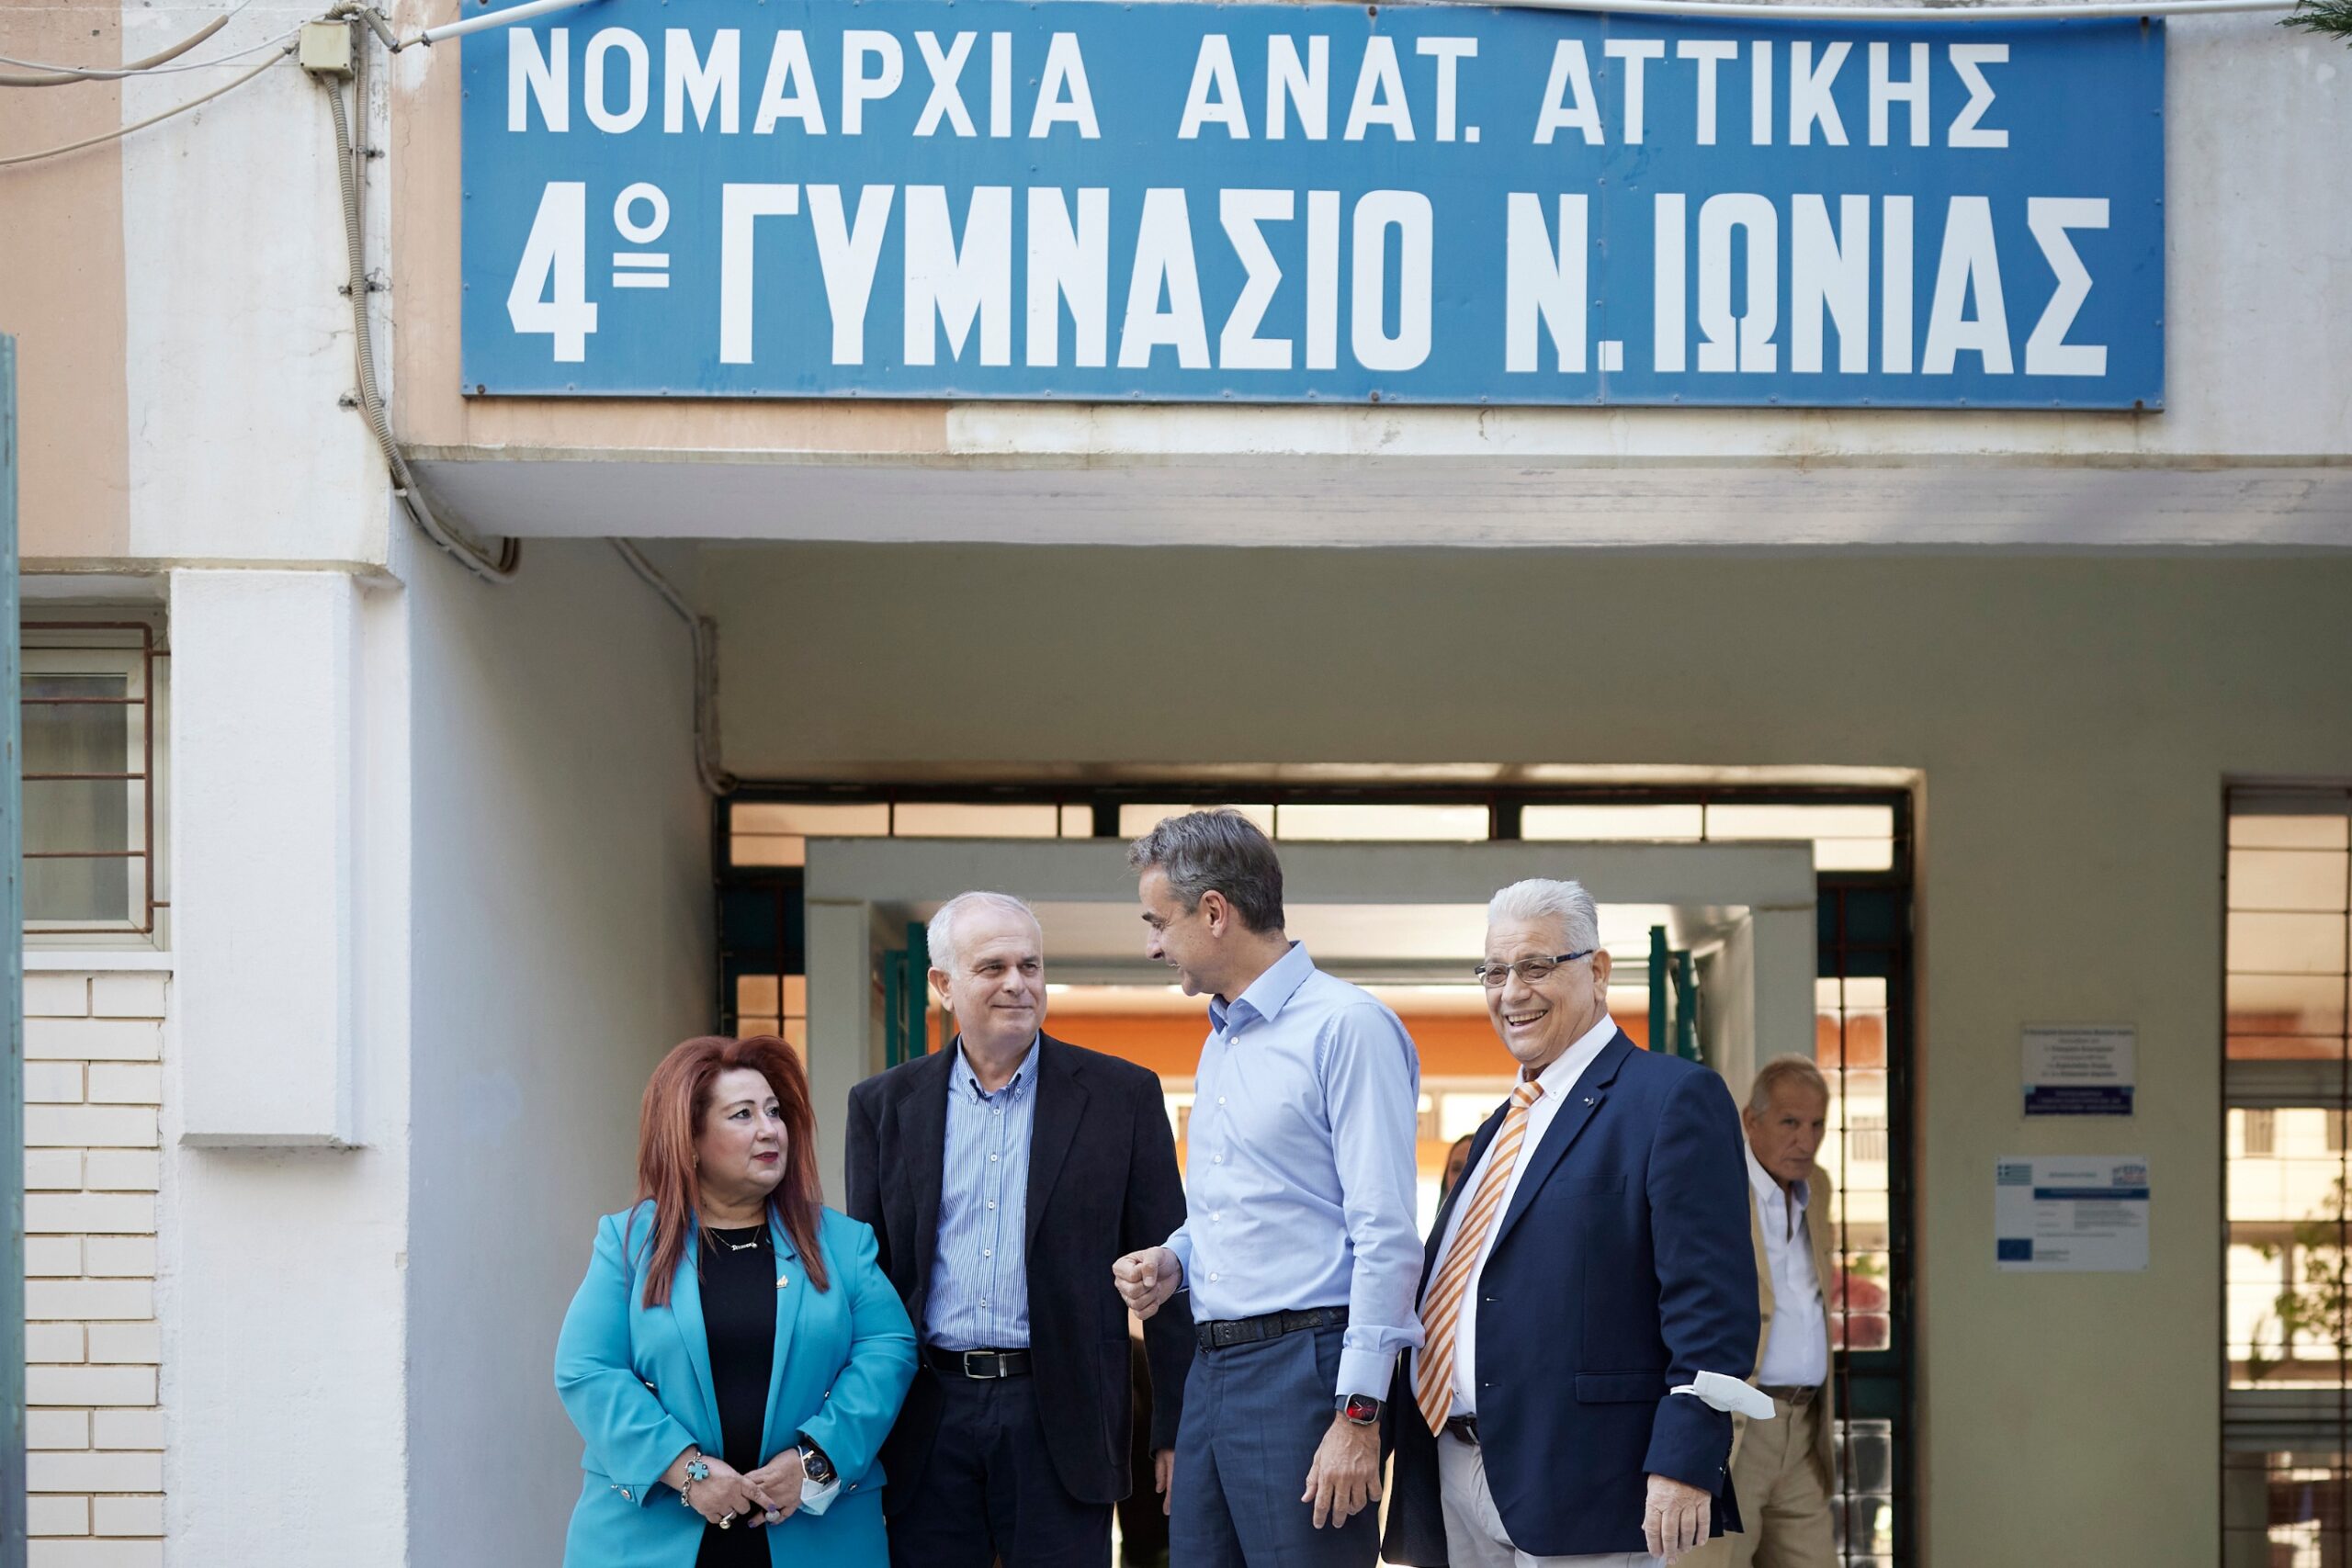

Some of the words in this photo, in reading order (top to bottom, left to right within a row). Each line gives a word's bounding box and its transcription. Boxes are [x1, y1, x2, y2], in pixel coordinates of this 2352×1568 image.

[507, 27, 1102, 139] ΝΟΜΑΡΧΙΑ
[1177, 33, 1480, 143] ΑΝΑΤ.
[1533, 39, 2009, 148] ΑΤΤΙΚΗΣ
[719, 183, 1433, 371] ΓΥΜΝΑΣΙΟ
[1506, 191, 1623, 373] Ν.
[1654, 193, 2109, 377] ΙΩΝΙΑΣ
